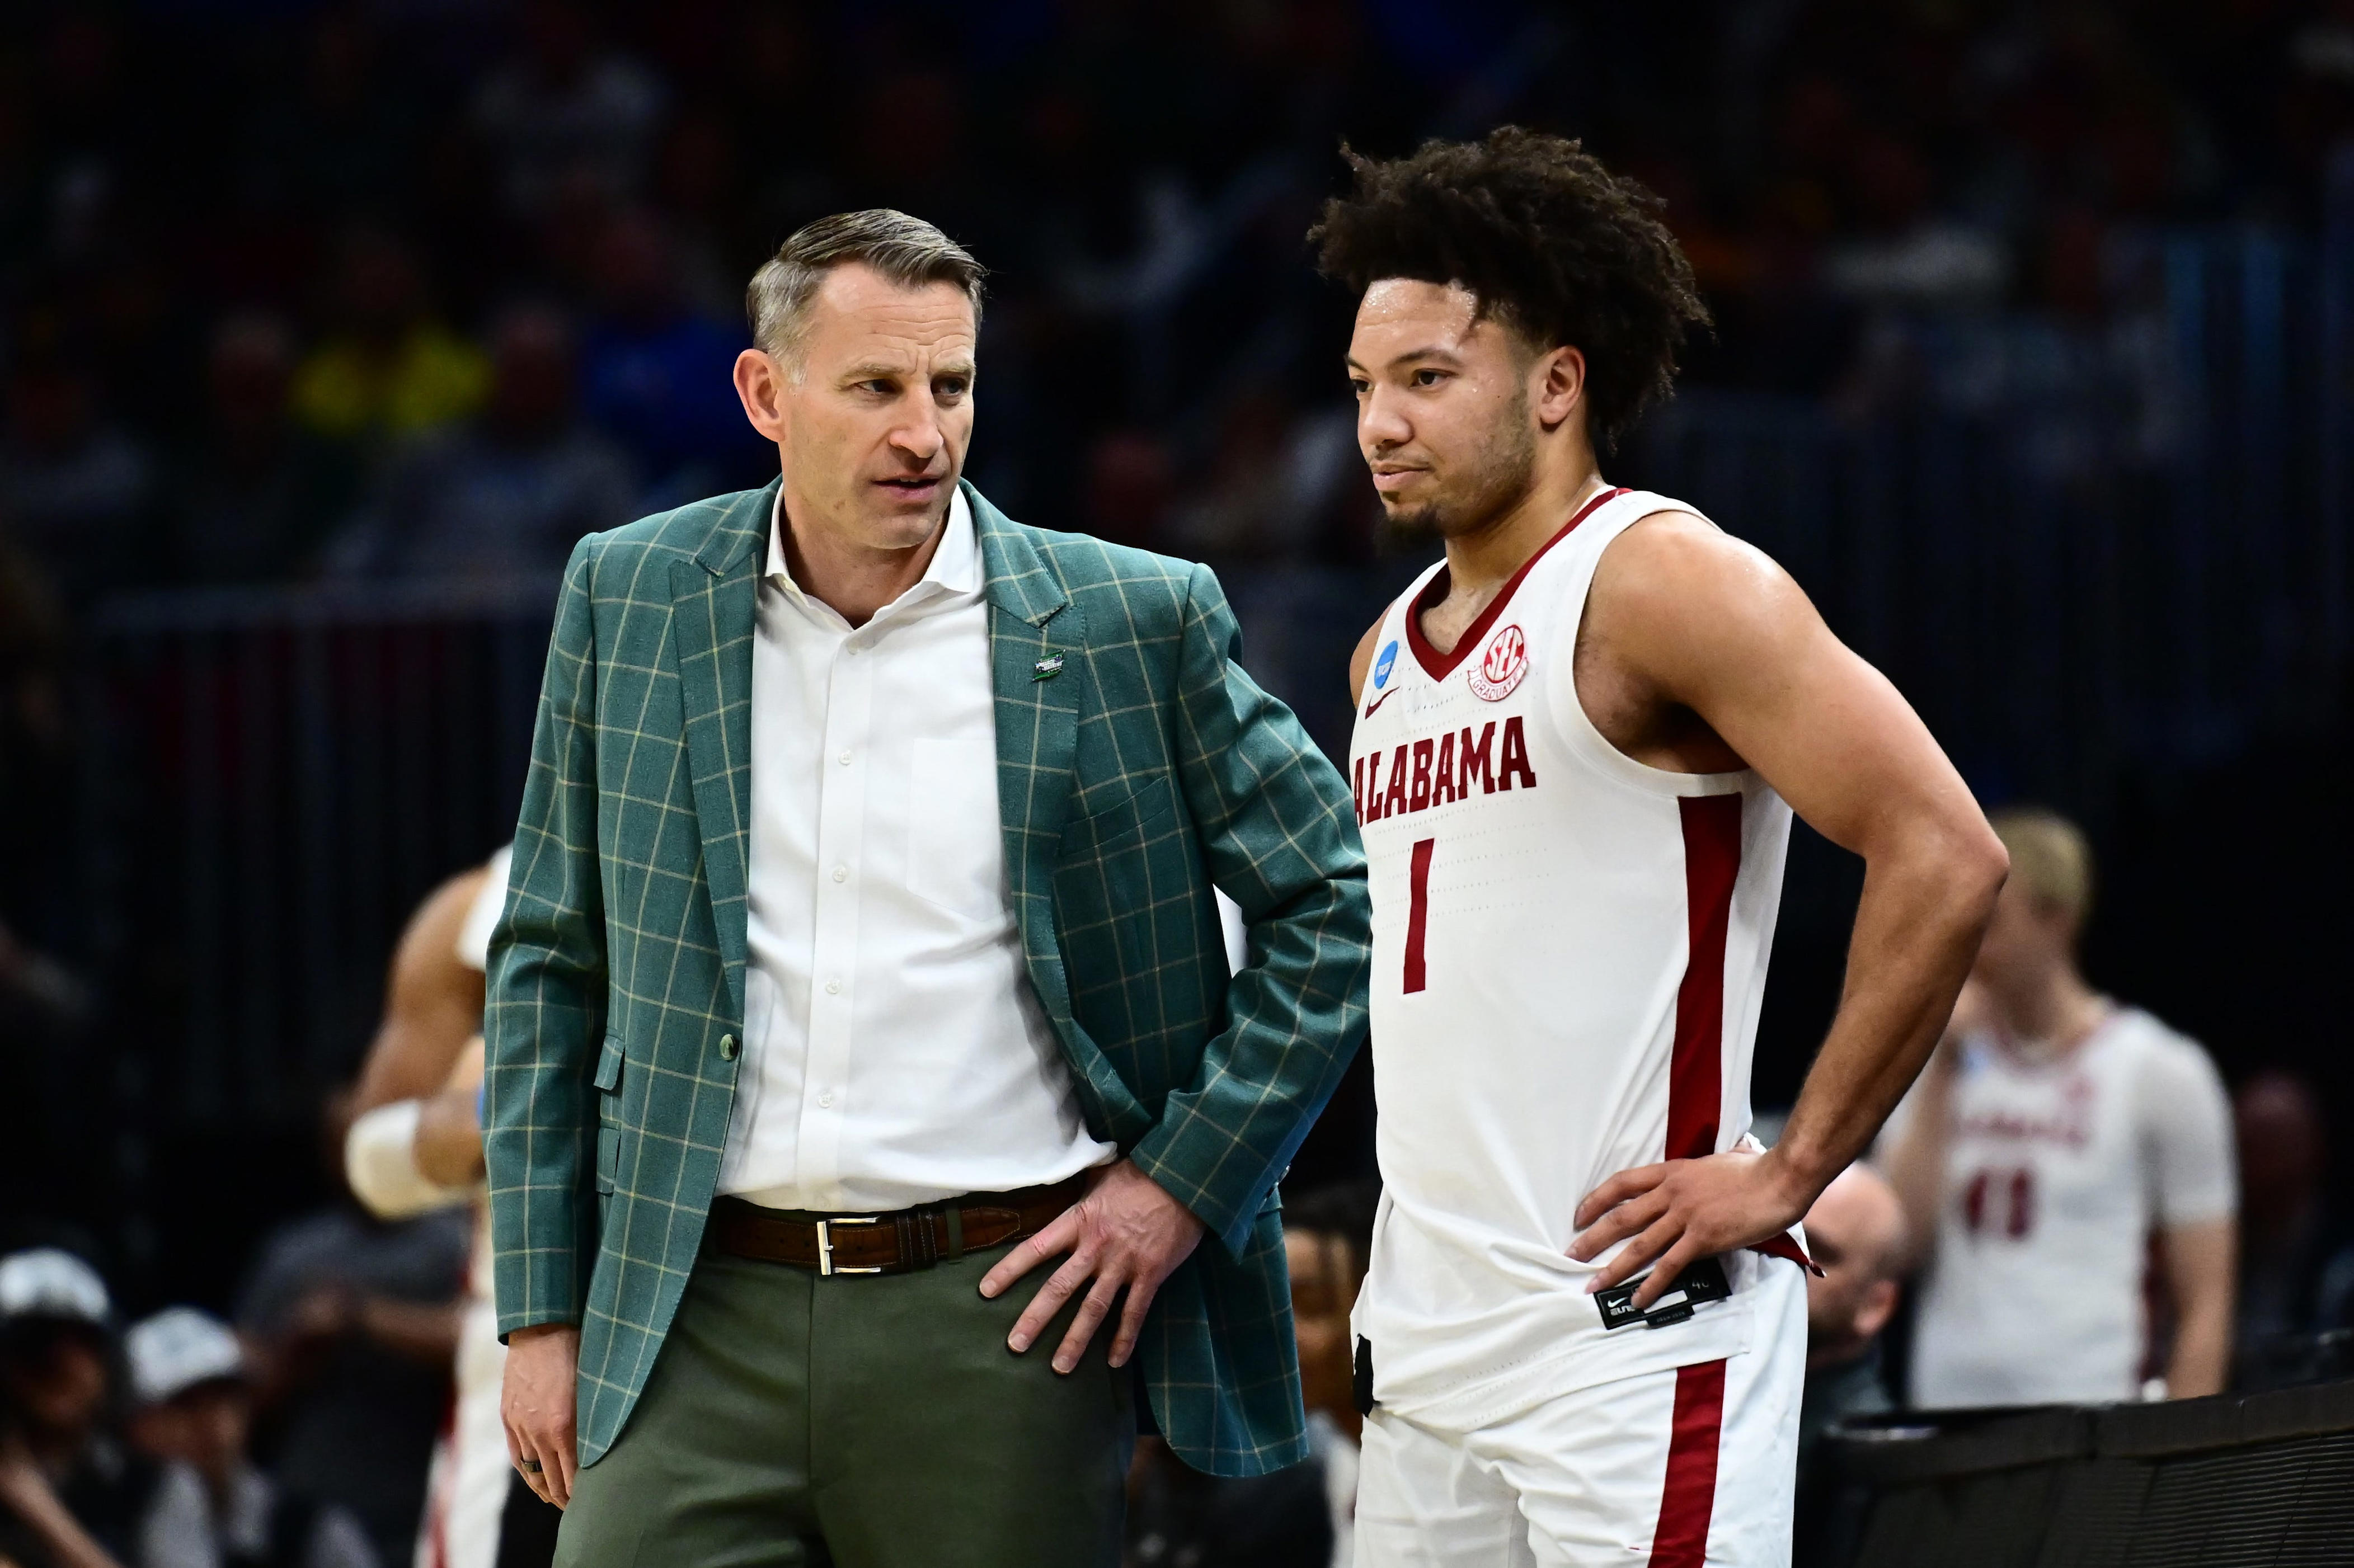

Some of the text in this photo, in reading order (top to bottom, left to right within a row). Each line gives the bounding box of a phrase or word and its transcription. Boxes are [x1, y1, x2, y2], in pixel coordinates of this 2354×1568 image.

[1473, 672, 1518, 699] GRADUATE
[1485, 626, 1524, 680] SEC
[1354, 716, 1537, 827] ALABAMA
[1403, 838, 1434, 994] 1
